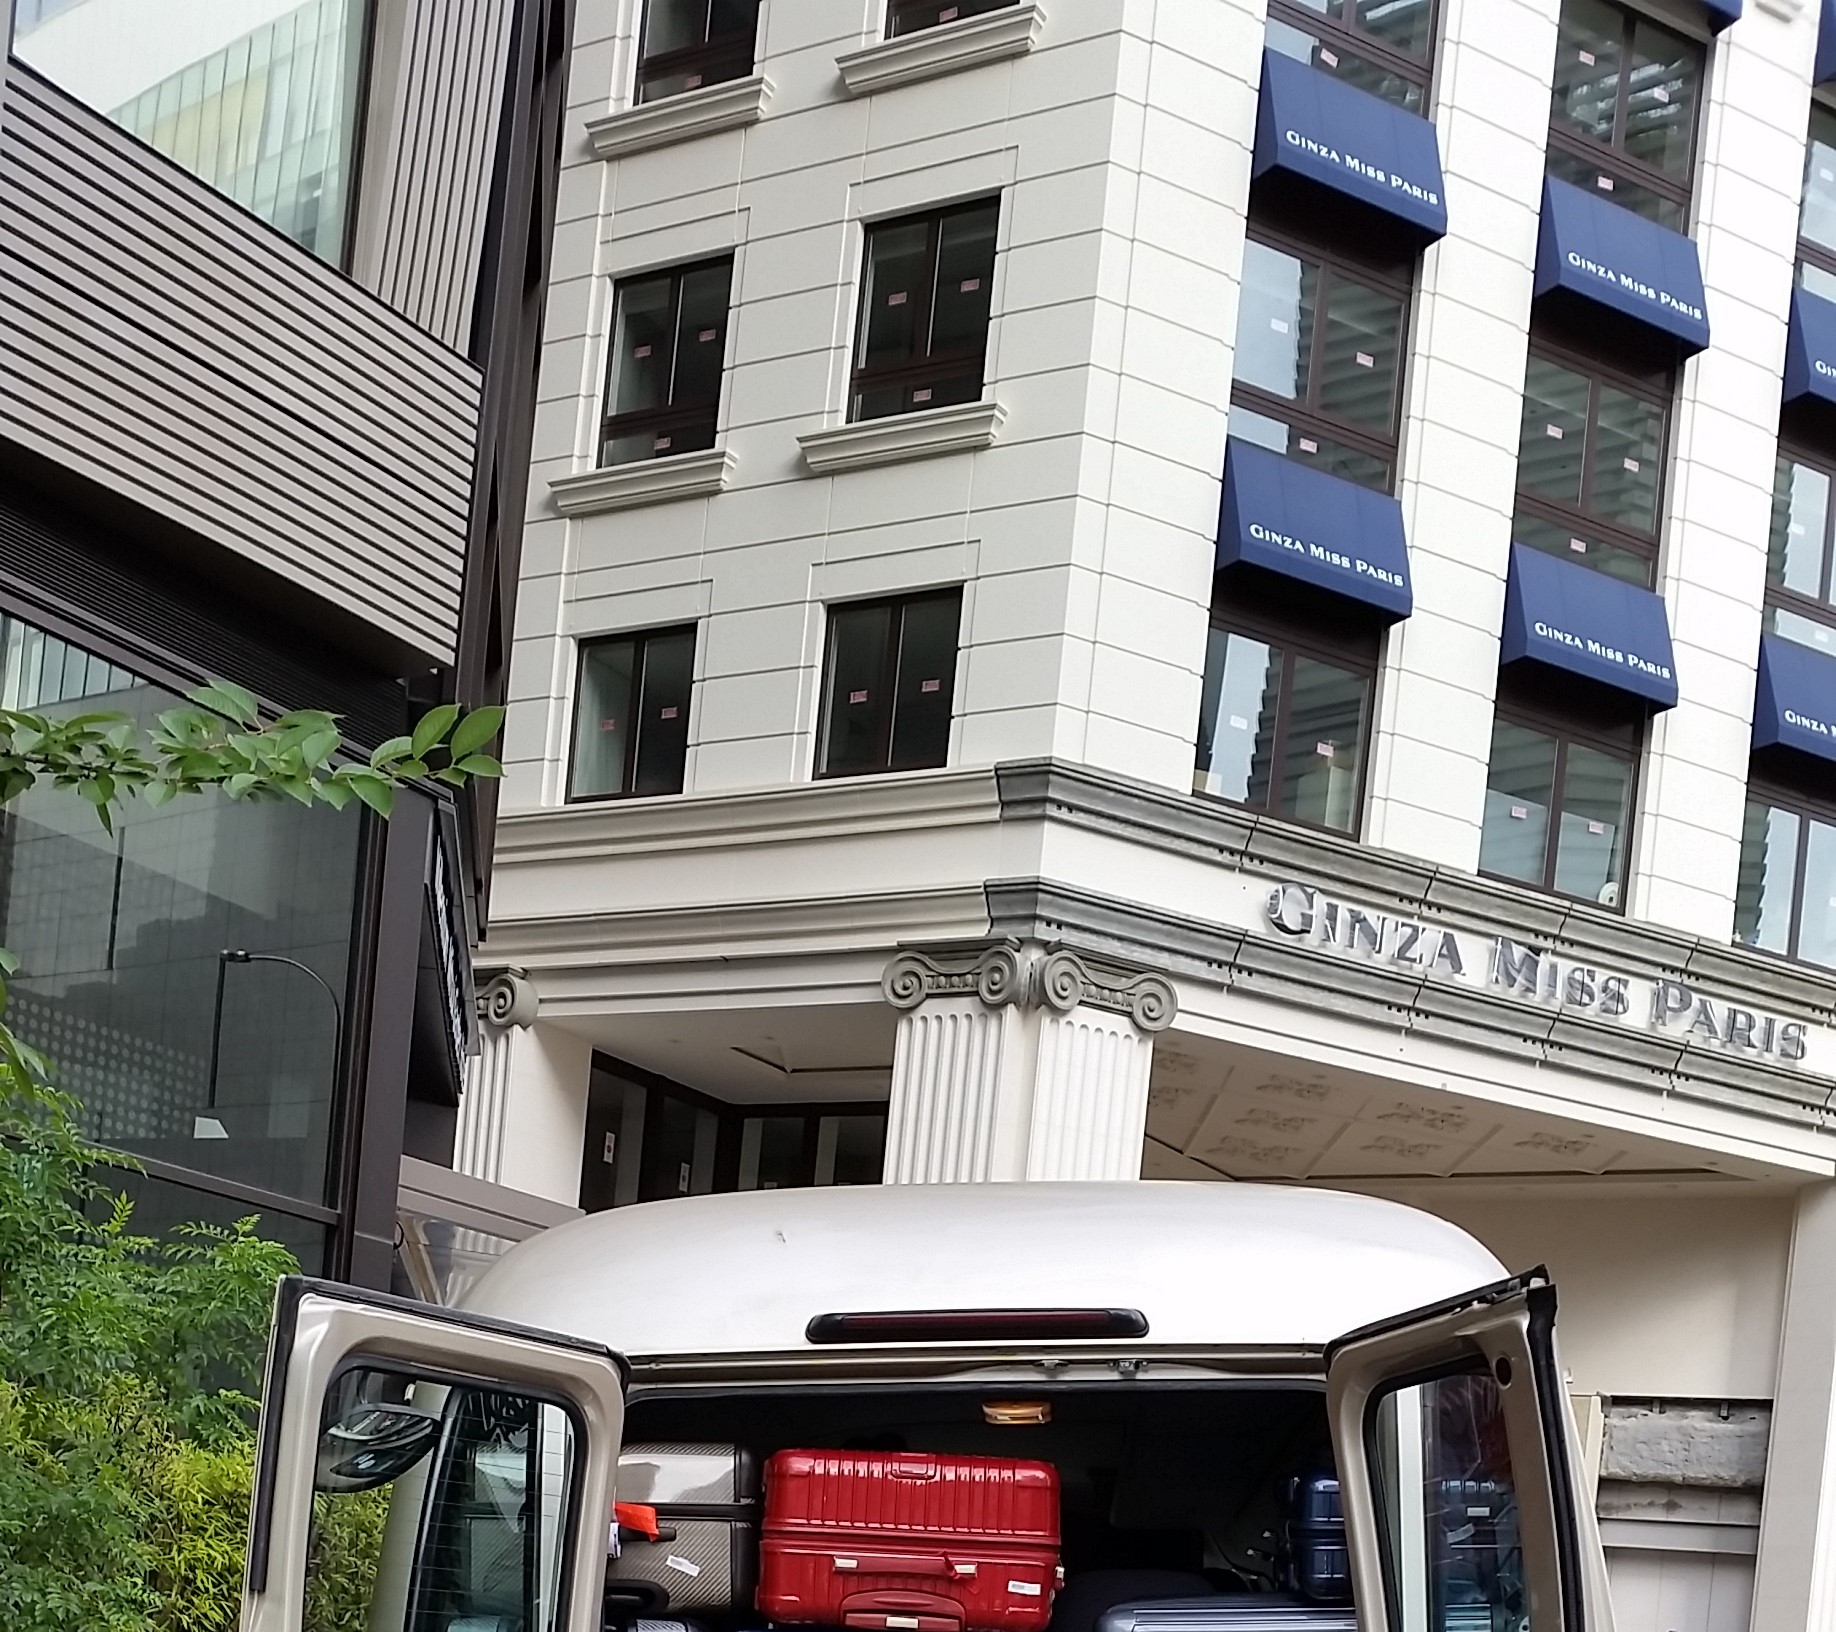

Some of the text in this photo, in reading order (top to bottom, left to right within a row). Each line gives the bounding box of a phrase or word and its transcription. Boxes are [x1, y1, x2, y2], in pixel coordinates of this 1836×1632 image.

[1286, 130, 1439, 205] GINZA MISS PARIS
[1568, 252, 1703, 320] GINZA MISS PARIS
[1249, 523, 1404, 587] GINZA MISS PARIS
[1534, 621, 1671, 679] GINZA MISS PARIS
[1784, 709, 1829, 735] GINZA
[1266, 880, 1809, 1062] GINZA MISS PARIS
